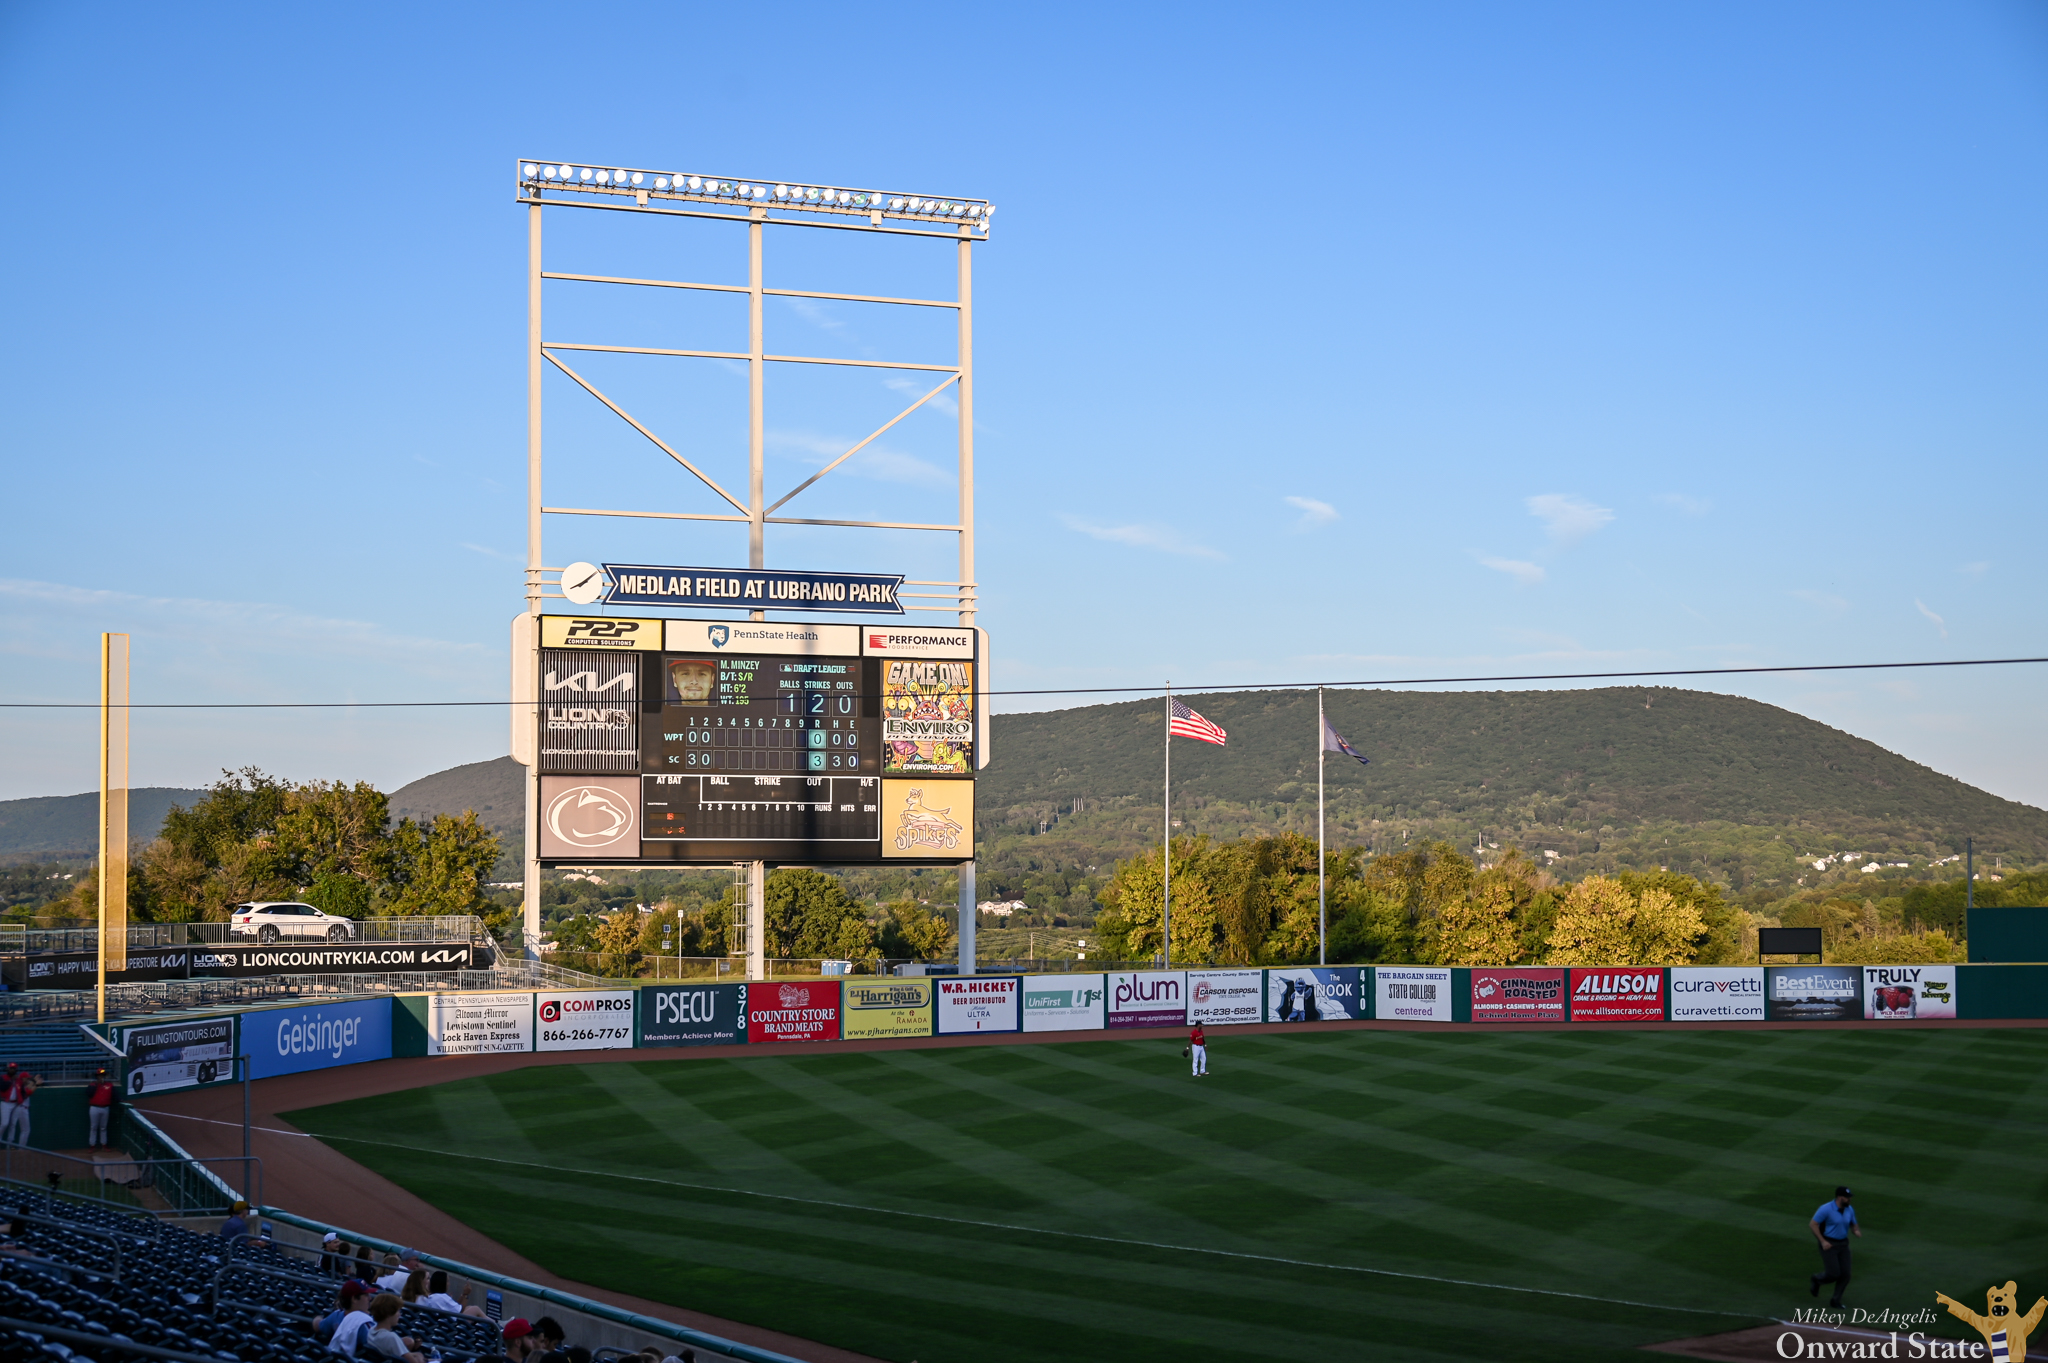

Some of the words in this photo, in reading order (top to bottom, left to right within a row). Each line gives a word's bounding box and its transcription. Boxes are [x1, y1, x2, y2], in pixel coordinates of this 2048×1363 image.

[620, 575, 692, 596] MEDLAR
[696, 577, 741, 598] FIELD
[744, 579, 765, 599] AT
[769, 580, 846, 601] LUBRANO
[850, 584, 893, 603] PARK
[567, 620, 640, 637] P2P
[733, 630, 784, 640] PennState
[786, 631, 818, 641] Health
[889, 635, 967, 646] PERFORMANCE
[720, 660, 730, 669] M.
[731, 660, 760, 670] MINZEY
[793, 664, 817, 673] DRAFT
[818, 665, 846, 673] LEAGUE
[720, 672, 737, 681] B/T:
[738, 672, 753, 681] S/R
[887, 662, 938, 685] GAME
[938, 663, 969, 687] ON!
[720, 684, 733, 692] HT:
[780, 680, 800, 688] BALLS
[804, 681, 831, 689] STRIKES
[836, 682, 853, 690] OUTS
[720, 695, 734, 704] WT:
[786, 693, 794, 713] 1
[811, 694, 824, 713] 2
[839, 694, 851, 714] 0
[548, 707, 606, 722] LION
[548, 721, 614, 730] COUNTRY
[690, 717, 694, 726] 1
[703, 717, 709, 726] 2
[717, 717, 723, 726] 3
[730, 718, 736, 726] 4
[744, 718, 750, 727] 5
[758, 718, 764, 727] 6
[772, 719, 777, 727] 7
[785, 719, 790, 727] 8
[799, 719, 804, 728] 9
[815, 719, 820, 728] R
[833, 720, 839, 728] H
[850, 720, 855, 728] E
[887, 719, 970, 735] ENVIRO
[664, 733, 684, 741] WPT
[688, 731, 697, 743] 0
[701, 731, 710, 743] 0
[814, 733, 822, 745] 0
[832, 733, 841, 745] 0
[848, 734, 856, 745] 0
[668, 755, 680, 764] SC
[688, 753, 696, 765] 3
[701, 753, 710, 765] 0
[814, 755, 822, 767] 3
[832, 755, 841, 767] 3
[848, 756, 856, 767] 0
[656, 776, 667, 785] AT
[668, 776, 682, 785] BAT
[710, 777, 729, 785] BALL
[754, 777, 781, 786] STRIKE
[807, 778, 822, 786] OUT
[860, 778, 873, 787] H/E
[814, 804, 832, 812] RUNS
[841, 804, 855, 812] HITS
[161, 953, 186, 968] KIA
[194, 954, 225, 962] LION
[243, 950, 415, 967] LIONCOUNTRYKIA.COM
[421, 949, 468, 963] KIA
[58, 961, 80, 974] HAPPY
[1329, 974, 1341, 982] The
[1392, 972, 1424, 980] BARGAIN
[1866, 969, 1921, 985] TRULY
[941, 983, 967, 994] W.R.
[968, 981, 1015, 993] HICKEY
[1500, 978, 1561, 990] CINNAMON
[1575, 974, 1660, 994] ALLISON
[1673, 977, 1761, 993] curavetti
[1775, 974, 1855, 990] BestEvent
[1116, 973, 1179, 1011] plum
[1228, 987, 1259, 995] DISPOSAL
[1316, 983, 1353, 997] NOOK
[1504, 988, 1558, 1000] ROASTED
[434, 997, 457, 1005] CENTRAL
[458, 996, 494, 1004] PENNSYLVANIA
[861, 988, 922, 1005] Harrigan's
[952, 997, 968, 1005] BEER
[969, 996, 1006, 1005] DISTRIBUTOR
[1028, 997, 1061, 1007] UniFirst
[563, 998, 631, 1012] COMPROS
[656, 990, 715, 1024] PSECU
[737, 985, 747, 1030] 378
[1674, 1006, 1763, 1015] curavetti.com
[455, 1008, 482, 1019] Altoona
[483, 1008, 509, 1019] Mirror
[751, 1009, 802, 1023] COUNTRY
[802, 1008, 836, 1021] STORE
[1193, 1007, 1257, 1017] 814-238-6895
[1395, 1007, 1433, 1016] centered
[1573, 1007, 1662, 1015] www.allisoncrane.com
[563, 1013, 631, 1021] INCORPORATED
[896, 1016, 928, 1024] RAMADA
[446, 1021, 485, 1031] Lewistown
[486, 1019, 516, 1030] Sentinel
[764, 1022, 795, 1034] BRAND
[795, 1021, 824, 1032] MEATS
[137, 1026, 227, 1047] FULLINGTONTOURS.COM
[277, 1013, 362, 1059] Geisinger
[442, 1033, 462, 1042] Lock
[463, 1032, 488, 1041] Haven
[490, 1031, 520, 1042] Express
[543, 1027, 630, 1042] 866-266-7767
[644, 1033, 680, 1041] Members
[682, 1032, 712, 1040] Achieve
[713, 1031, 734, 1039] More
[847, 1027, 929, 1037] www.pjharrigans.com
[436, 1044, 483, 1053] WILLIAMSPORT
[483, 1043, 525, 1052] SUN-GAZETTE
